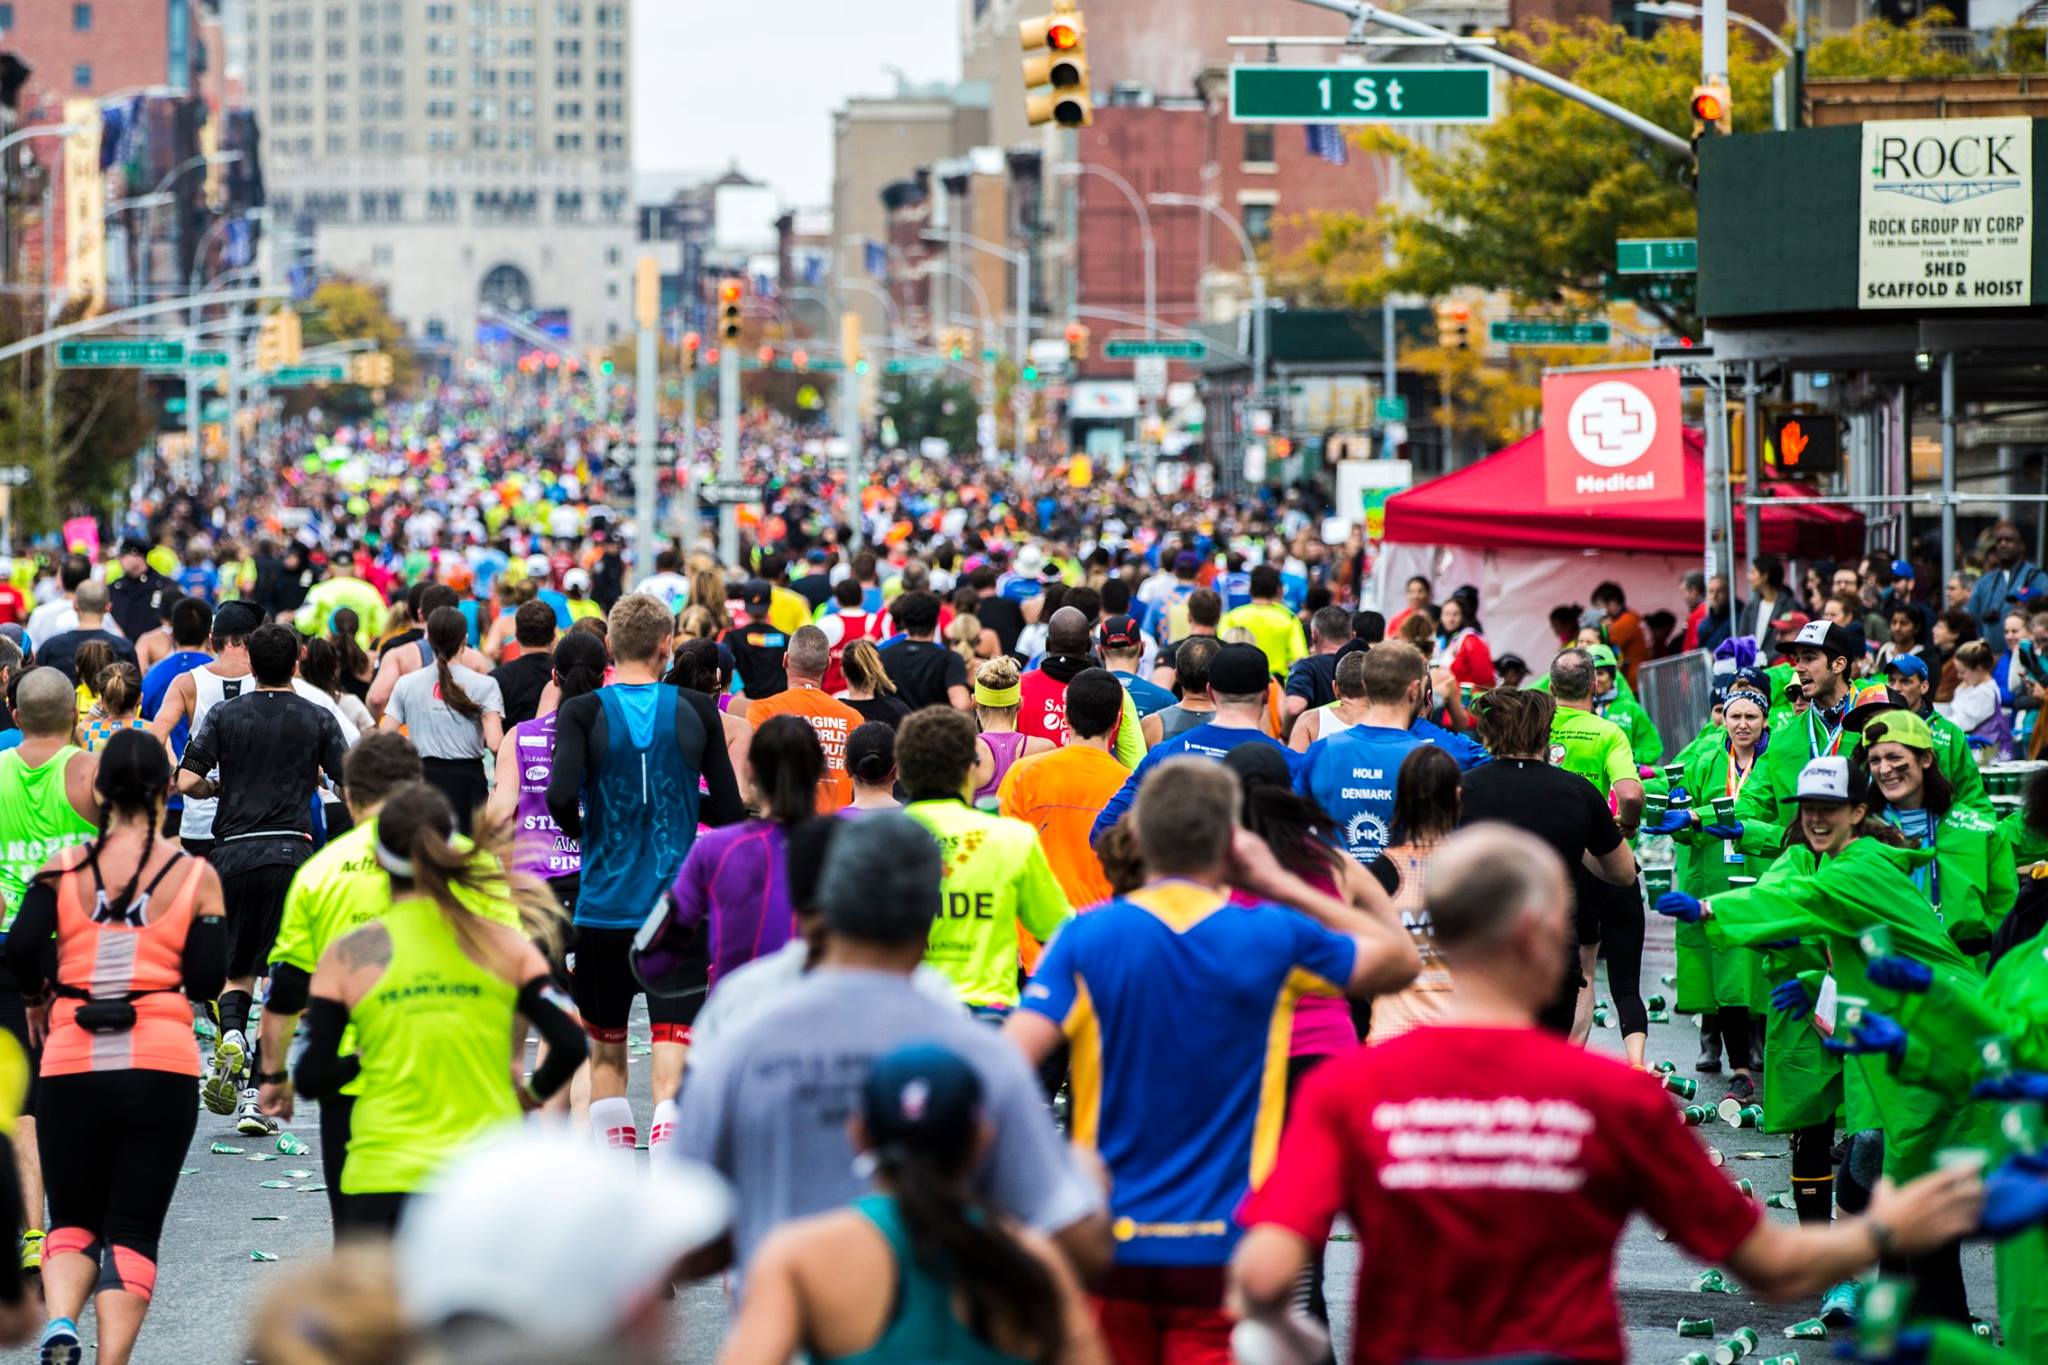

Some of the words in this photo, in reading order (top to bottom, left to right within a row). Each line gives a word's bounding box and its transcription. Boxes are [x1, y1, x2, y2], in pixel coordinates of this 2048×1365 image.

[1318, 77, 1331, 110] 1
[1352, 77, 1404, 110] St
[1882, 136, 2019, 179] ROCK
[1869, 219, 1906, 236] ROCK
[1911, 218, 1959, 234] GROUP
[1964, 218, 1982, 233] NY
[1987, 217, 2024, 233] CORP
[1665, 245, 1685, 257] ST
[1925, 262, 1966, 277] SHED
[1868, 283, 1948, 298] SCAFFOLD
[1955, 282, 1967, 296] &
[1974, 280, 2023, 296] HOIST
[1576, 471, 1654, 494] Medical
[827, 757, 844, 770] ER
[1353, 768, 1383, 779] HOLM
[1341, 788, 1392, 800] DENMARK
[1357, 829, 1379, 840] HK
[550, 856, 581, 870] PIN
